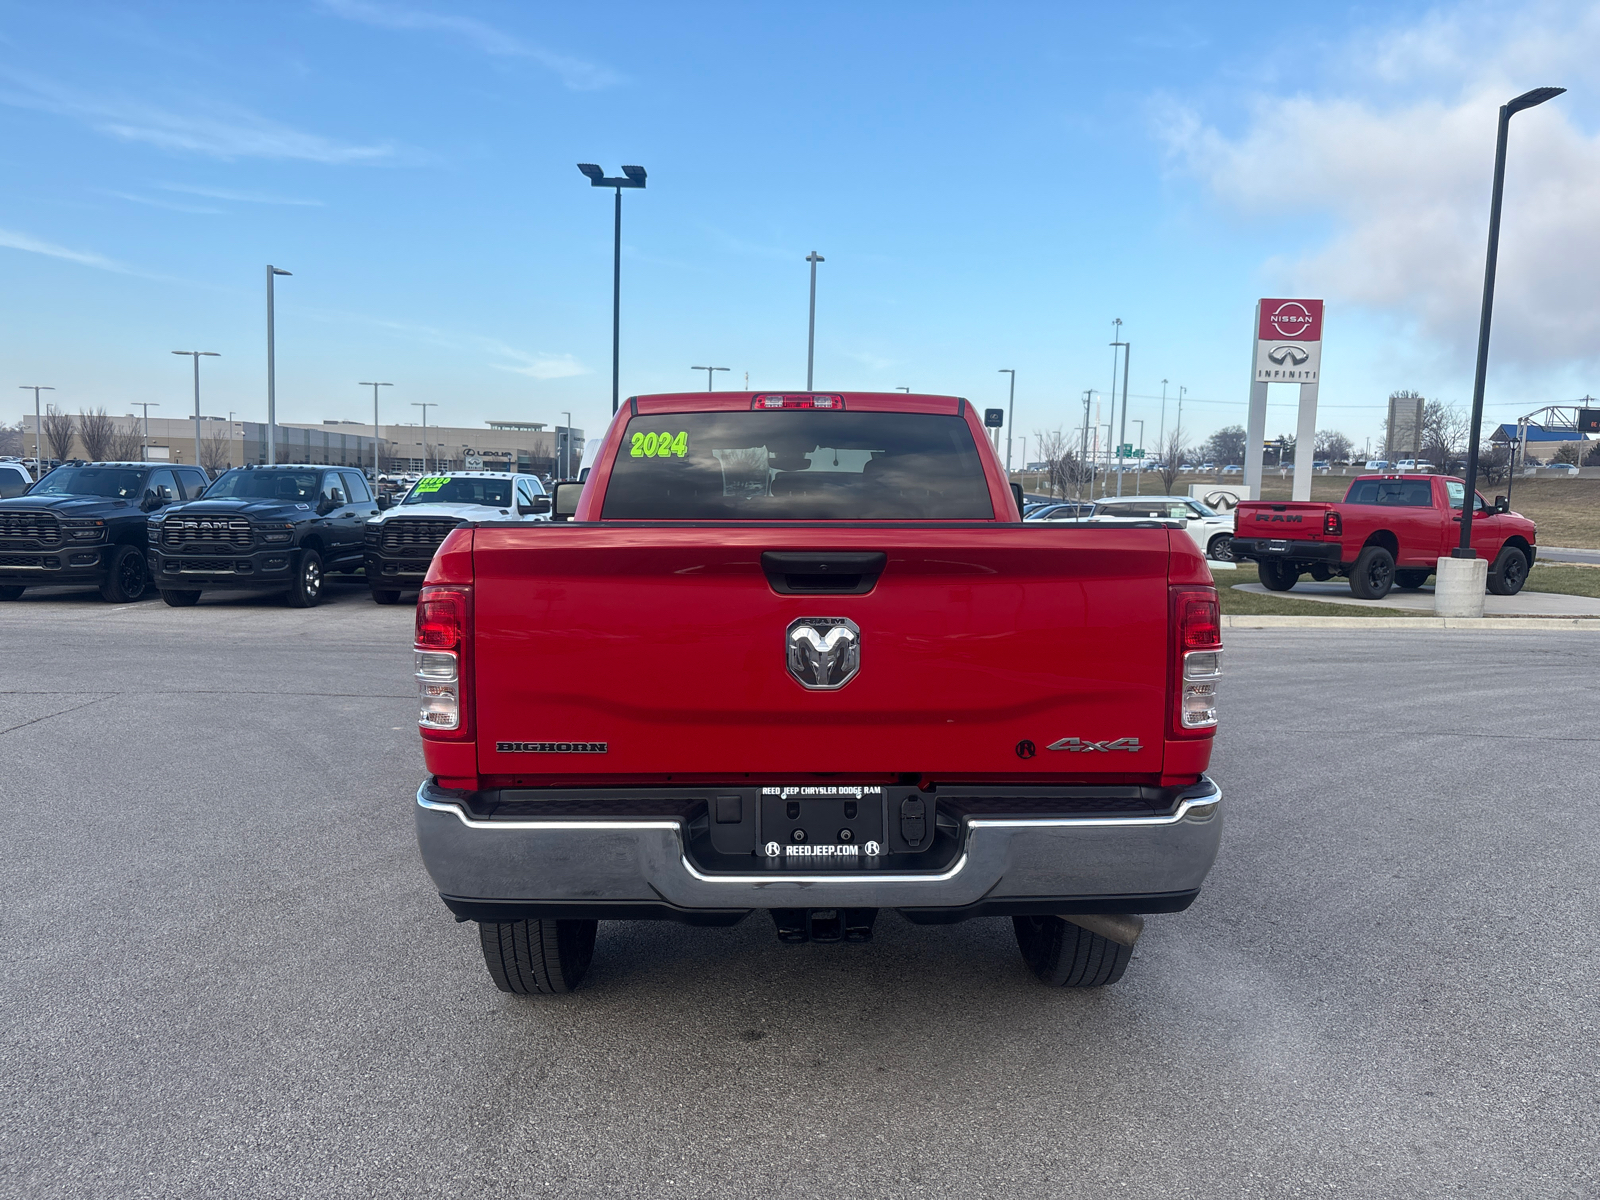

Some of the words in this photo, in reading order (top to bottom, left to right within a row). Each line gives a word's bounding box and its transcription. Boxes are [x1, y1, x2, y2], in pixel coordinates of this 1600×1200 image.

[1270, 315, 1313, 323] NISSAN
[1258, 370, 1316, 379] INFINITI
[630, 431, 688, 458] 2024
[1255, 513, 1303, 523] RAM
[184, 521, 228, 529] RAM
[800, 618, 846, 626] RAM
[496, 741, 608, 753] BIGHORN
[1046, 737, 1143, 752] 4x4
[762, 787, 781, 795] REED
[782, 786, 800, 795] JEEP
[800, 786, 837, 795] CHRYSLER
[838, 786, 862, 795] DODGE
[863, 786, 881, 794] RAM
[786, 845, 859, 856] REEDJEEP.COM
